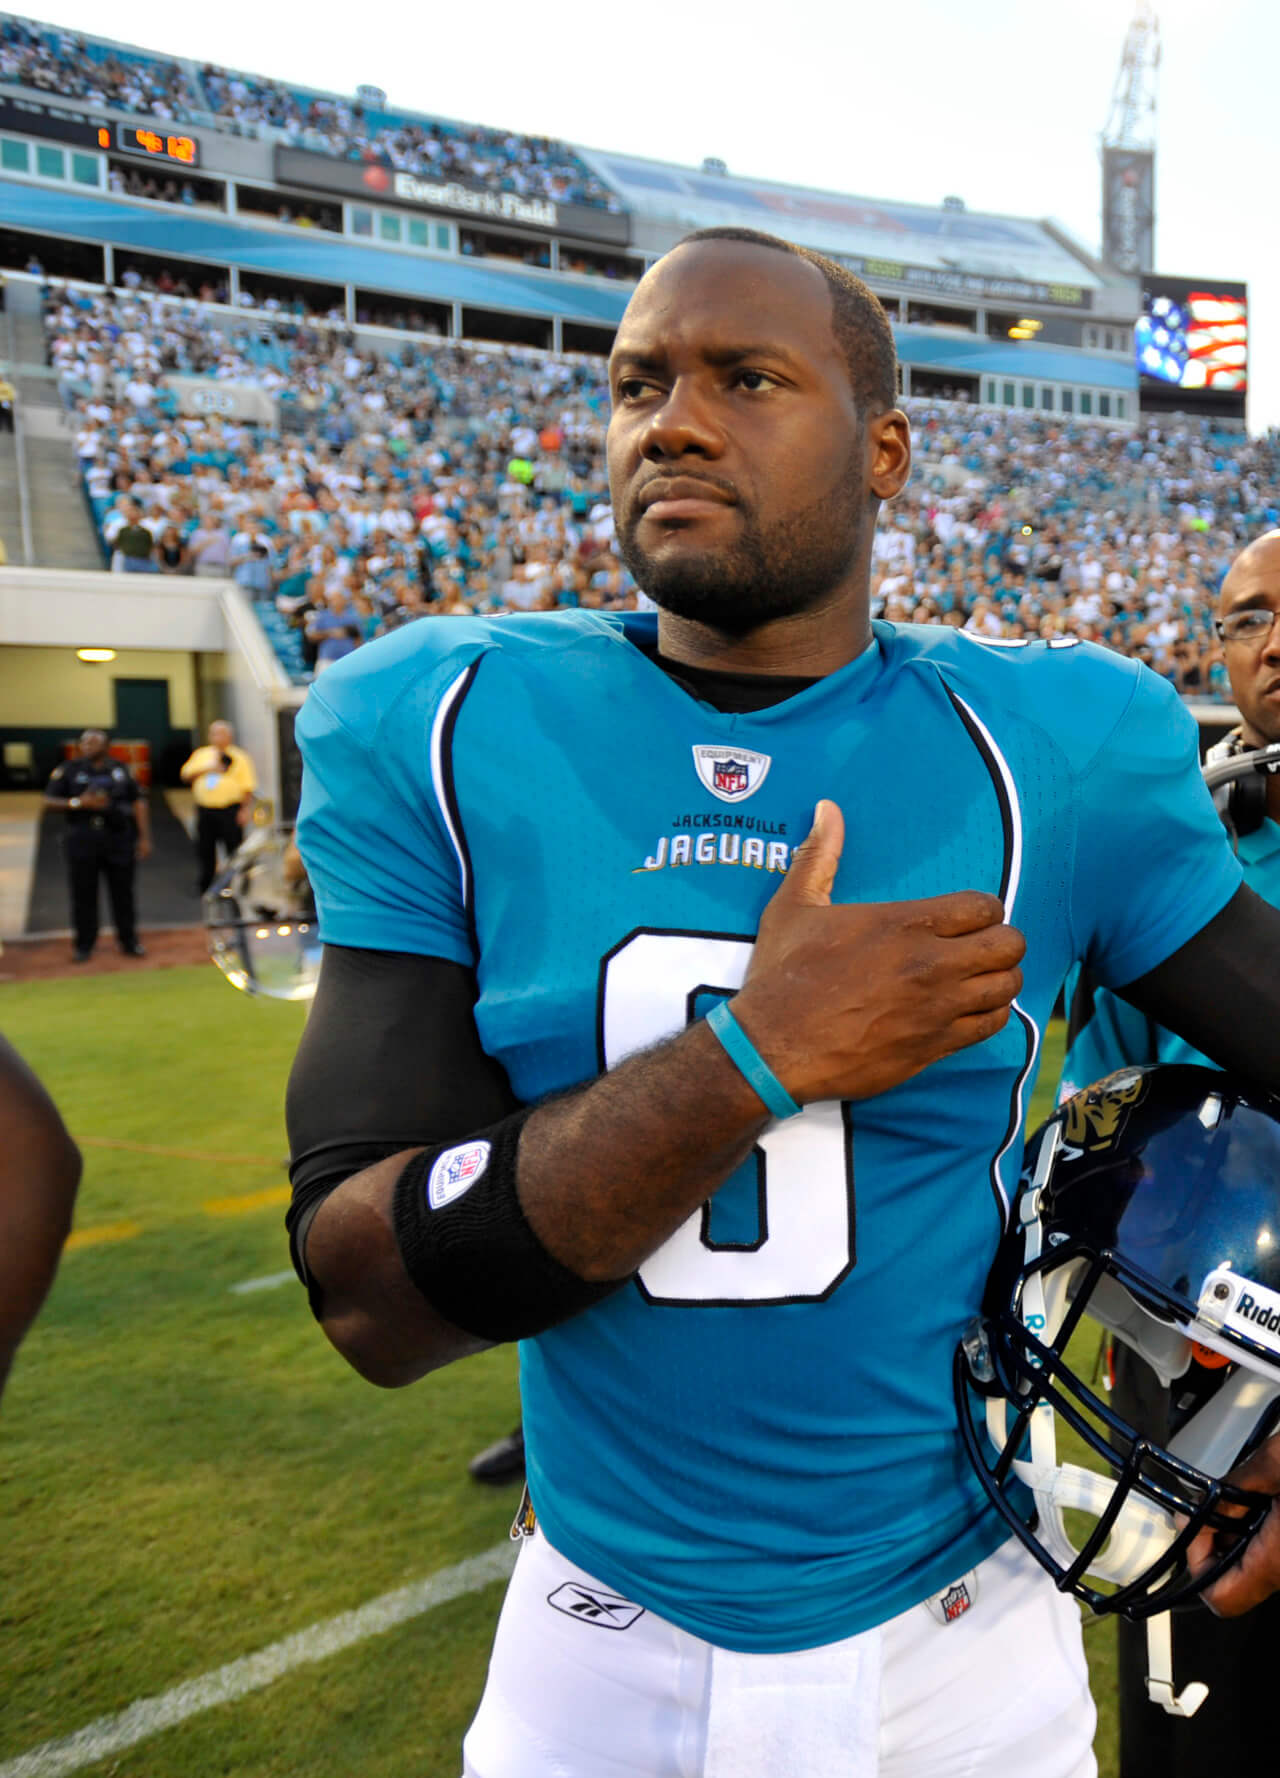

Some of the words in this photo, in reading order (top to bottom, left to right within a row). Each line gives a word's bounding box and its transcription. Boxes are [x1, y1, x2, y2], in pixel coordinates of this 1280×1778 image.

[716, 773, 746, 792] NFL
[672, 814, 787, 835] JACKSONVILLE
[633, 832, 800, 874] JAGUAR
